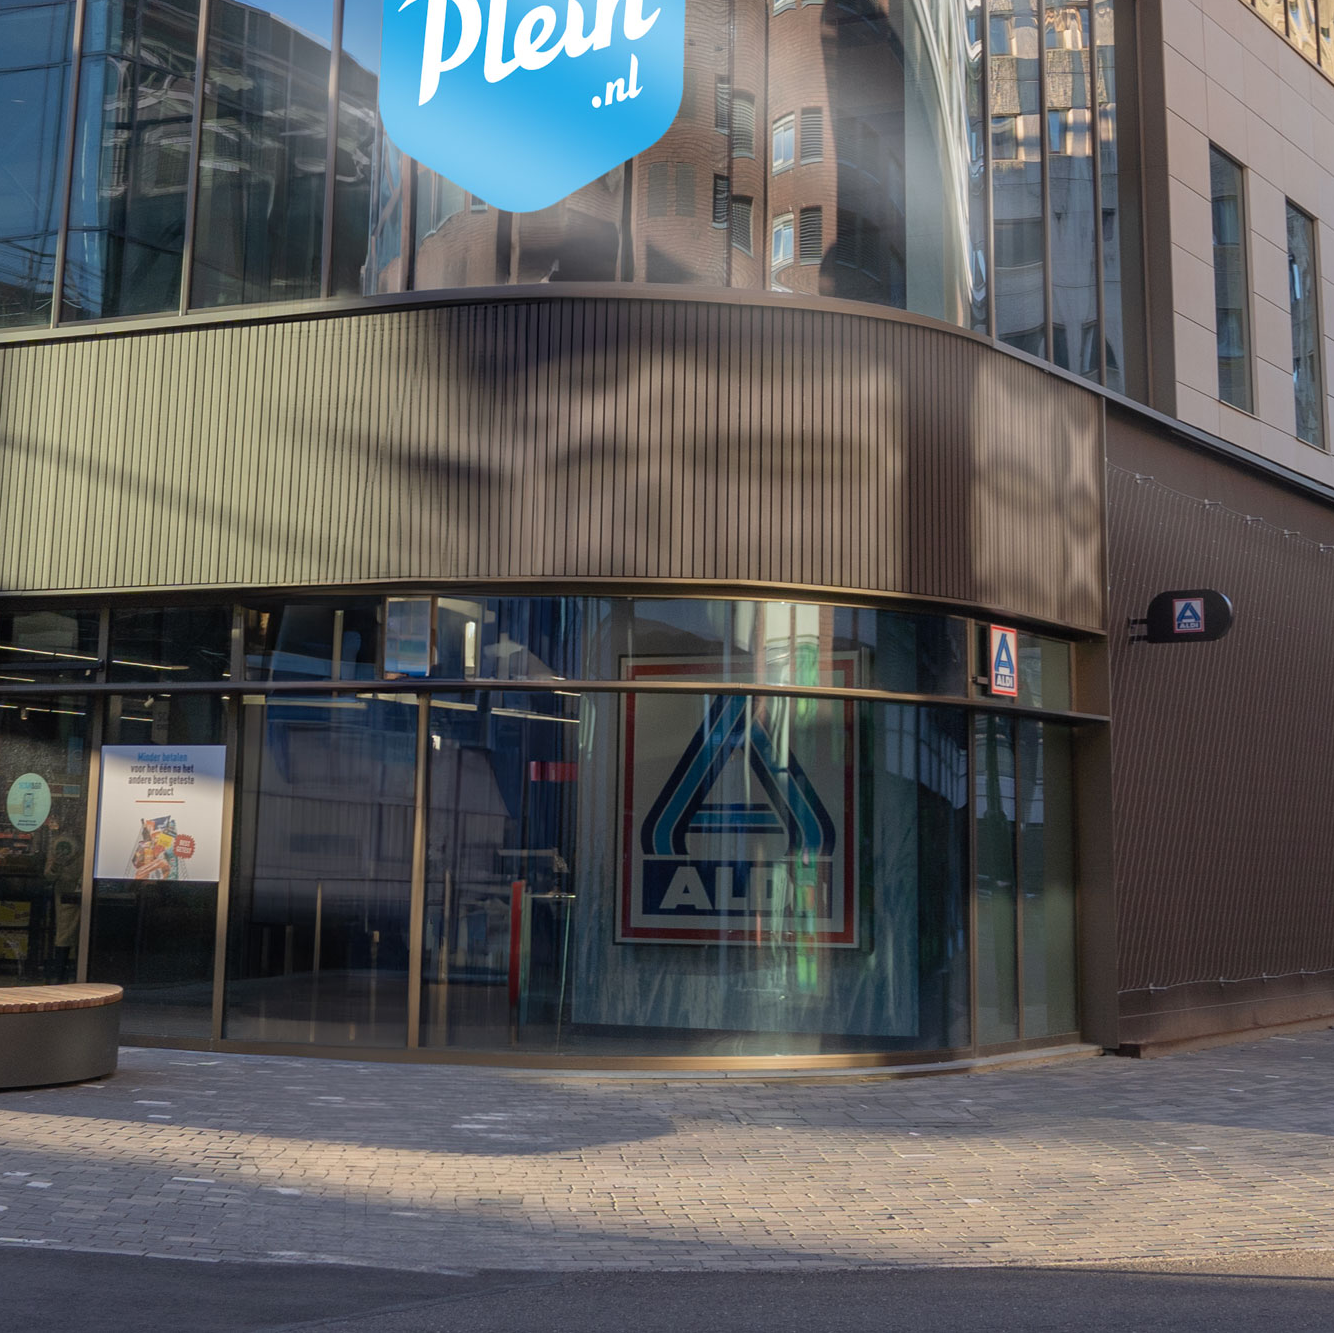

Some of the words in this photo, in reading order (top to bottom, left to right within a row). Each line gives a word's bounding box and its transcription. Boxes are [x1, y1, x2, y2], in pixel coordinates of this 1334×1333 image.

[591, 53, 644, 109] .nl
[1178, 622, 1200, 630] ALDI
[995, 675, 1014, 688] ALDI
[137, 752, 161, 762] Minder
[162, 752, 188, 762] betalen
[130, 765, 147, 773] voor
[147, 764, 159, 773] het
[182, 764, 195, 773] het
[128, 775, 152, 785] andere
[153, 775, 169, 785] best
[169, 776, 195, 787] geteste
[147, 787, 174, 797] product
[658, 865, 819, 911] ALD
